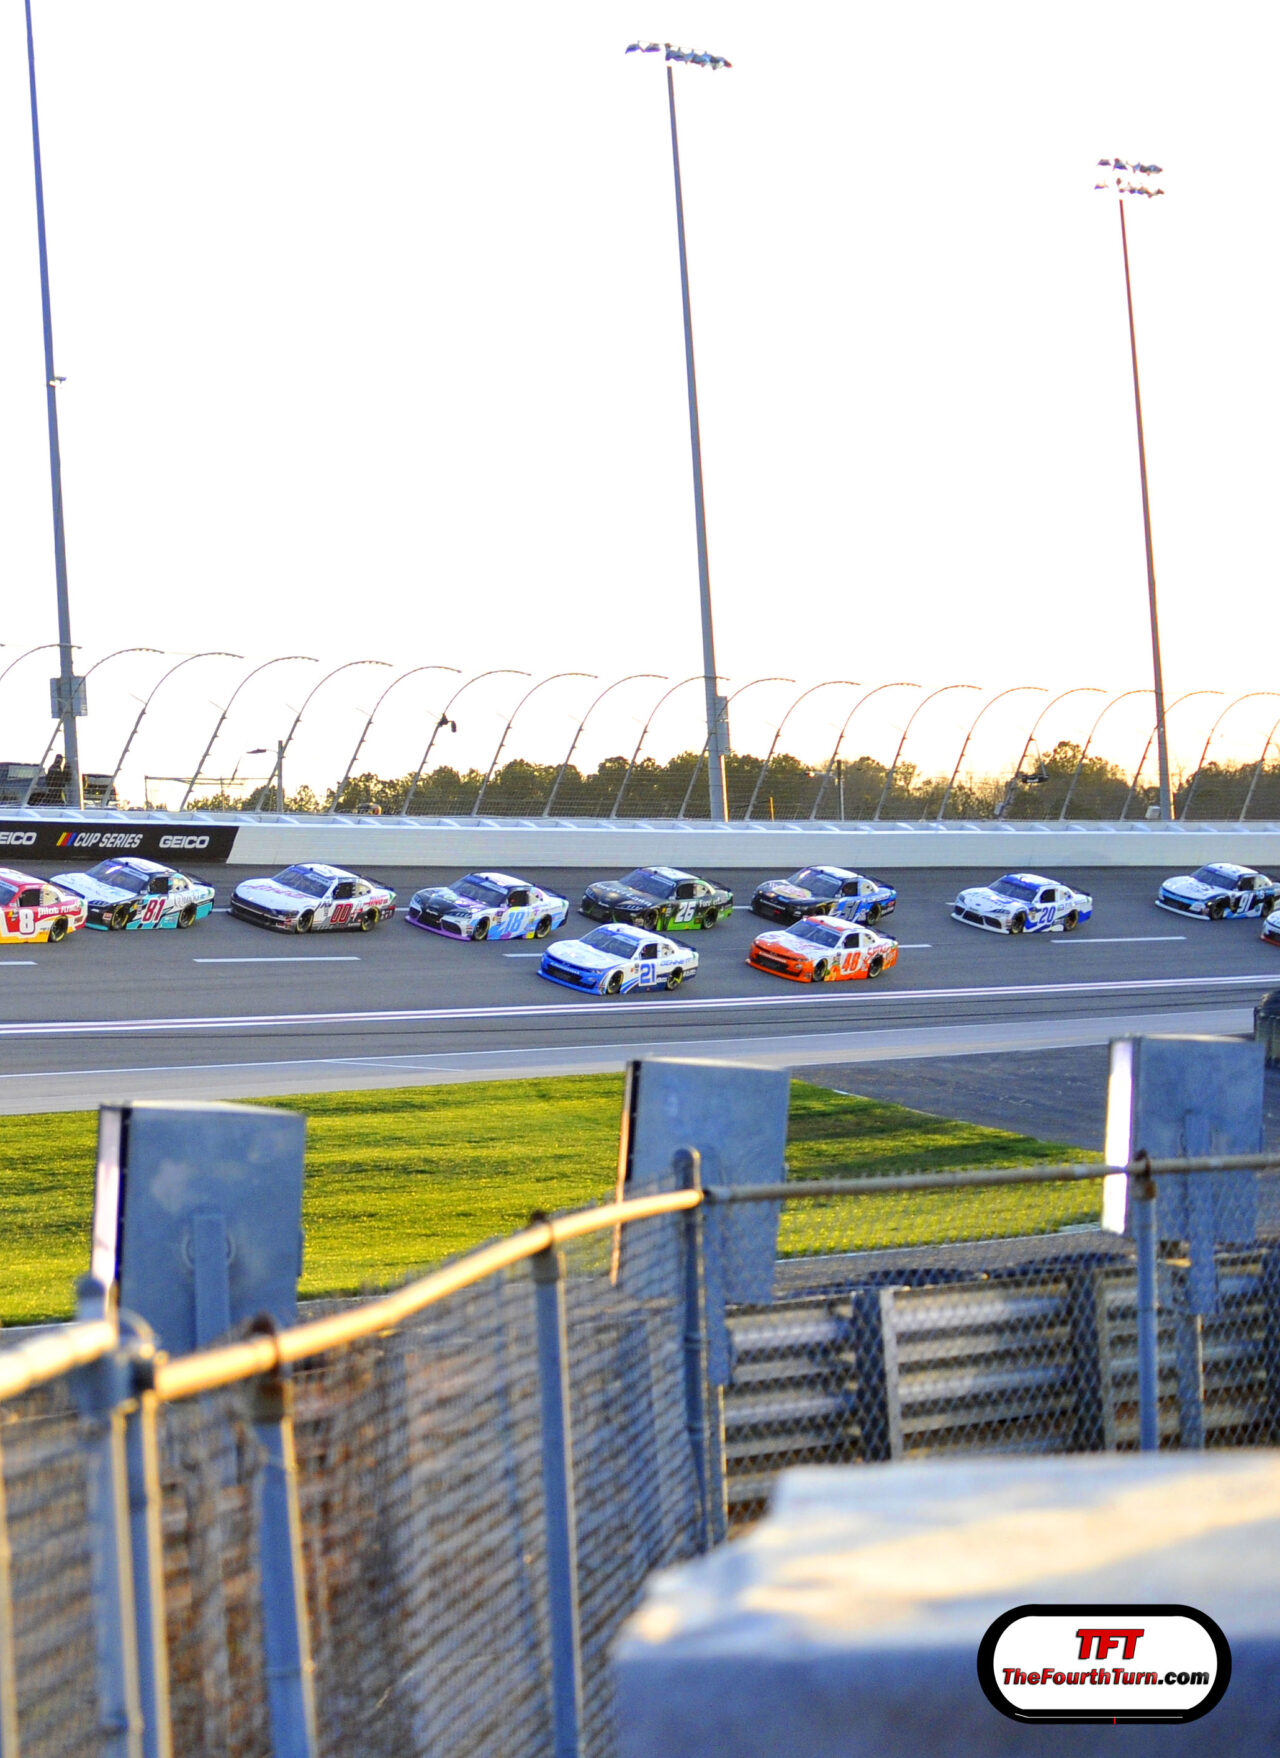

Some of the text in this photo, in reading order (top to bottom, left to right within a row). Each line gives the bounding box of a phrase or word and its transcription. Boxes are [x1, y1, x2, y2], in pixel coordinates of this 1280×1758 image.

[73, 832, 143, 848] CUP SERIES
[159, 835, 210, 848] GEICO
[141, 898, 167, 923] 81
[674, 901, 697, 922] 26
[1236, 892, 1255, 913] 91
[19, 899, 36, 934] 8
[330, 903, 353, 924] 00
[504, 911, 526, 933] 18
[1038, 907, 1056, 924] 20
[640, 963, 656, 984] 21
